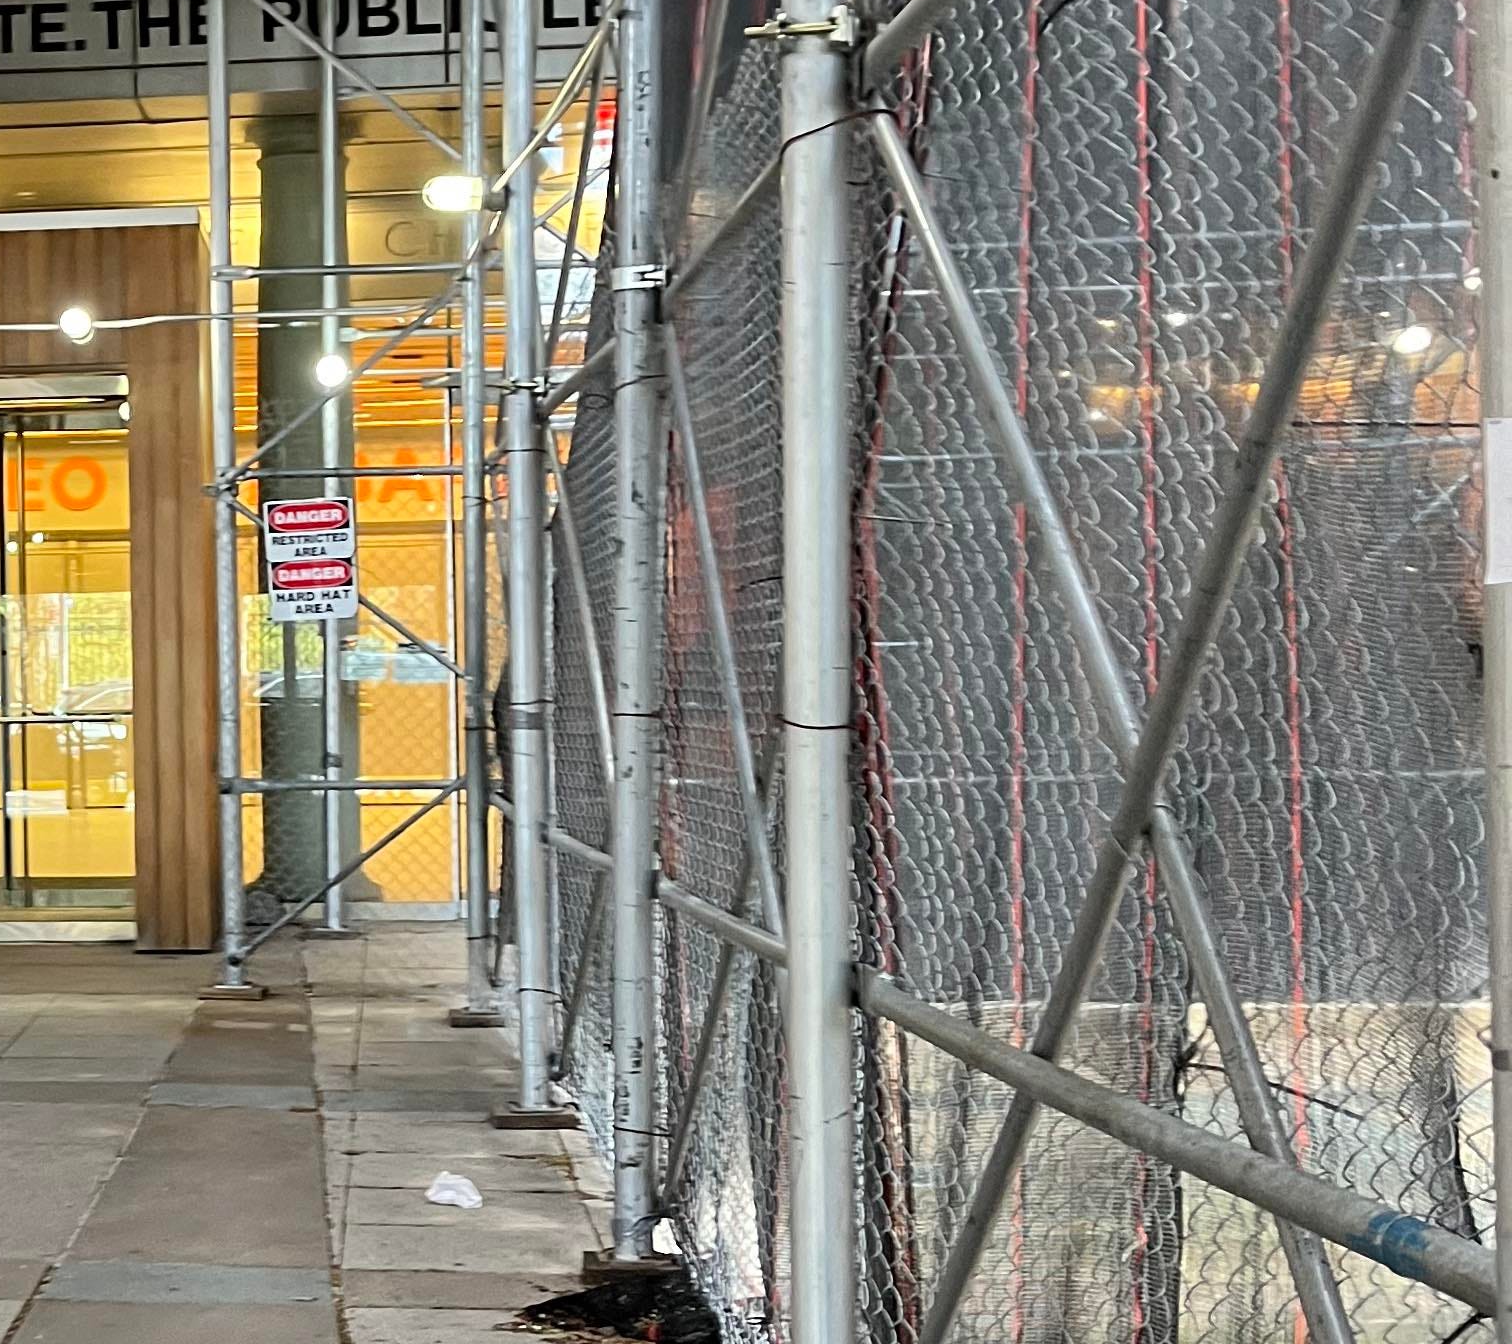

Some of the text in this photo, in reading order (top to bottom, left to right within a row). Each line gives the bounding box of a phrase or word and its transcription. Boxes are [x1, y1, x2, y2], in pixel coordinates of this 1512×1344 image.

[274, 508, 343, 524] DANGER
[272, 533, 348, 545] RESTRICTED
[294, 547, 327, 557] AREA
[278, 566, 346, 581] DANGER
[276, 589, 351, 602] HARD HAT
[295, 604, 334, 614] AREA
